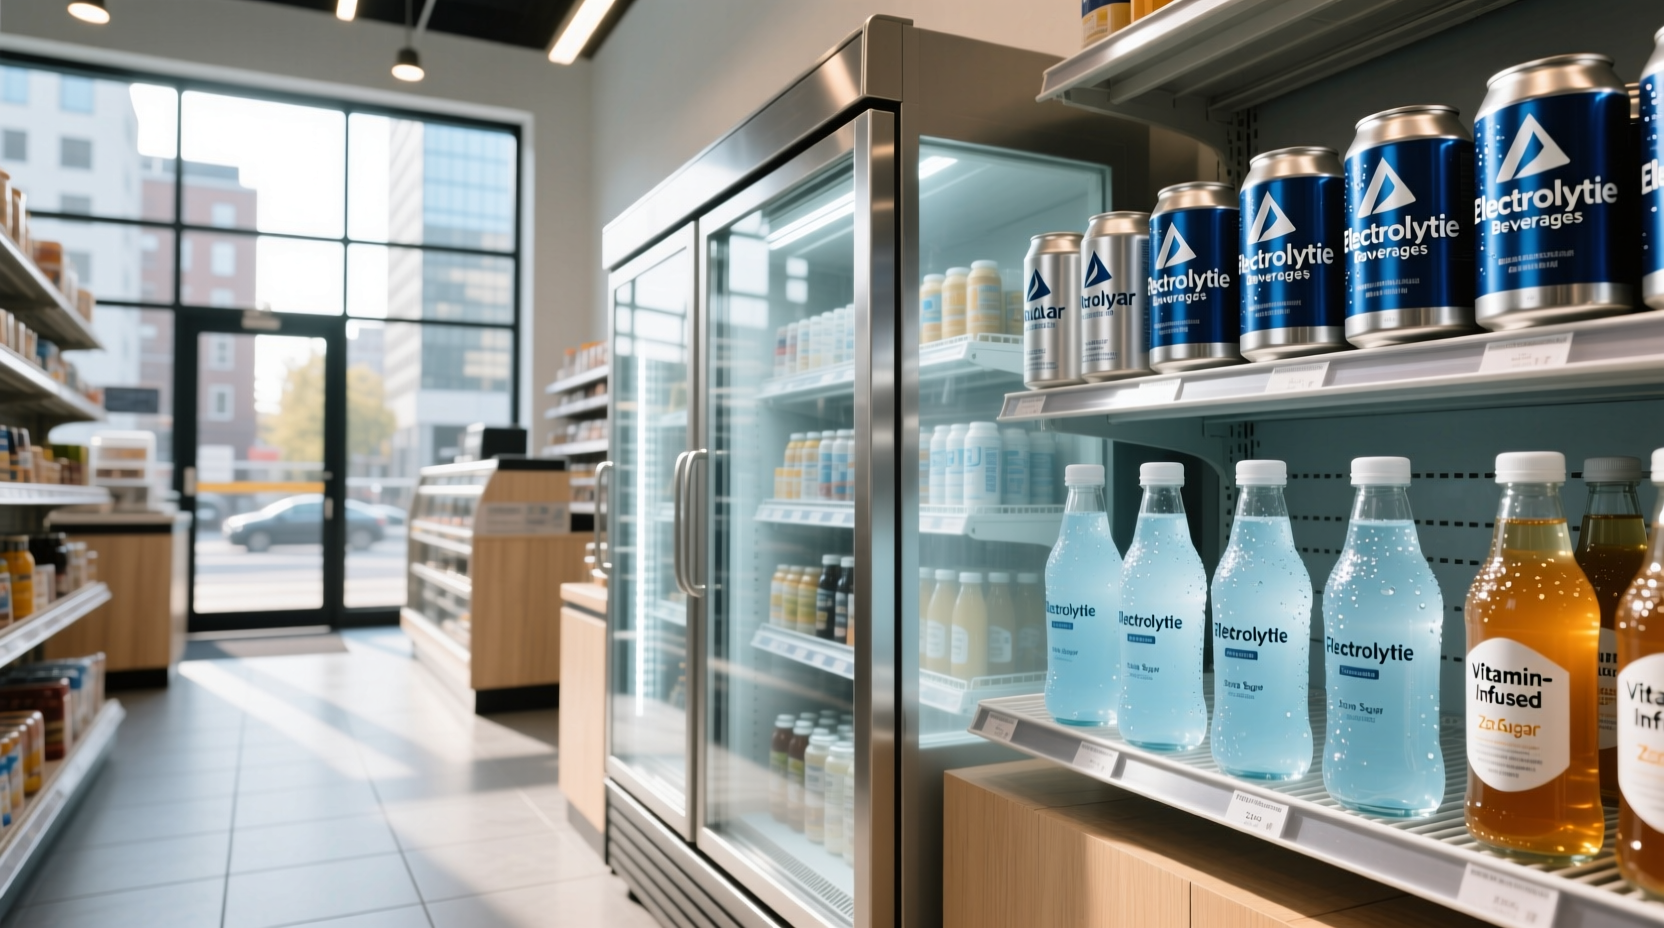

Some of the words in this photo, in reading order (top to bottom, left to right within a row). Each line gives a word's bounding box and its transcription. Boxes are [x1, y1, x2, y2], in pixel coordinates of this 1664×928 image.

[1474, 175, 1618, 225] Electrolytie
[1491, 211, 1584, 235] Beverages
[1472, 662, 1552, 687] Vitamin-
[1476, 684, 1542, 709] Infused
[1635, 708, 1664, 730] Inf
